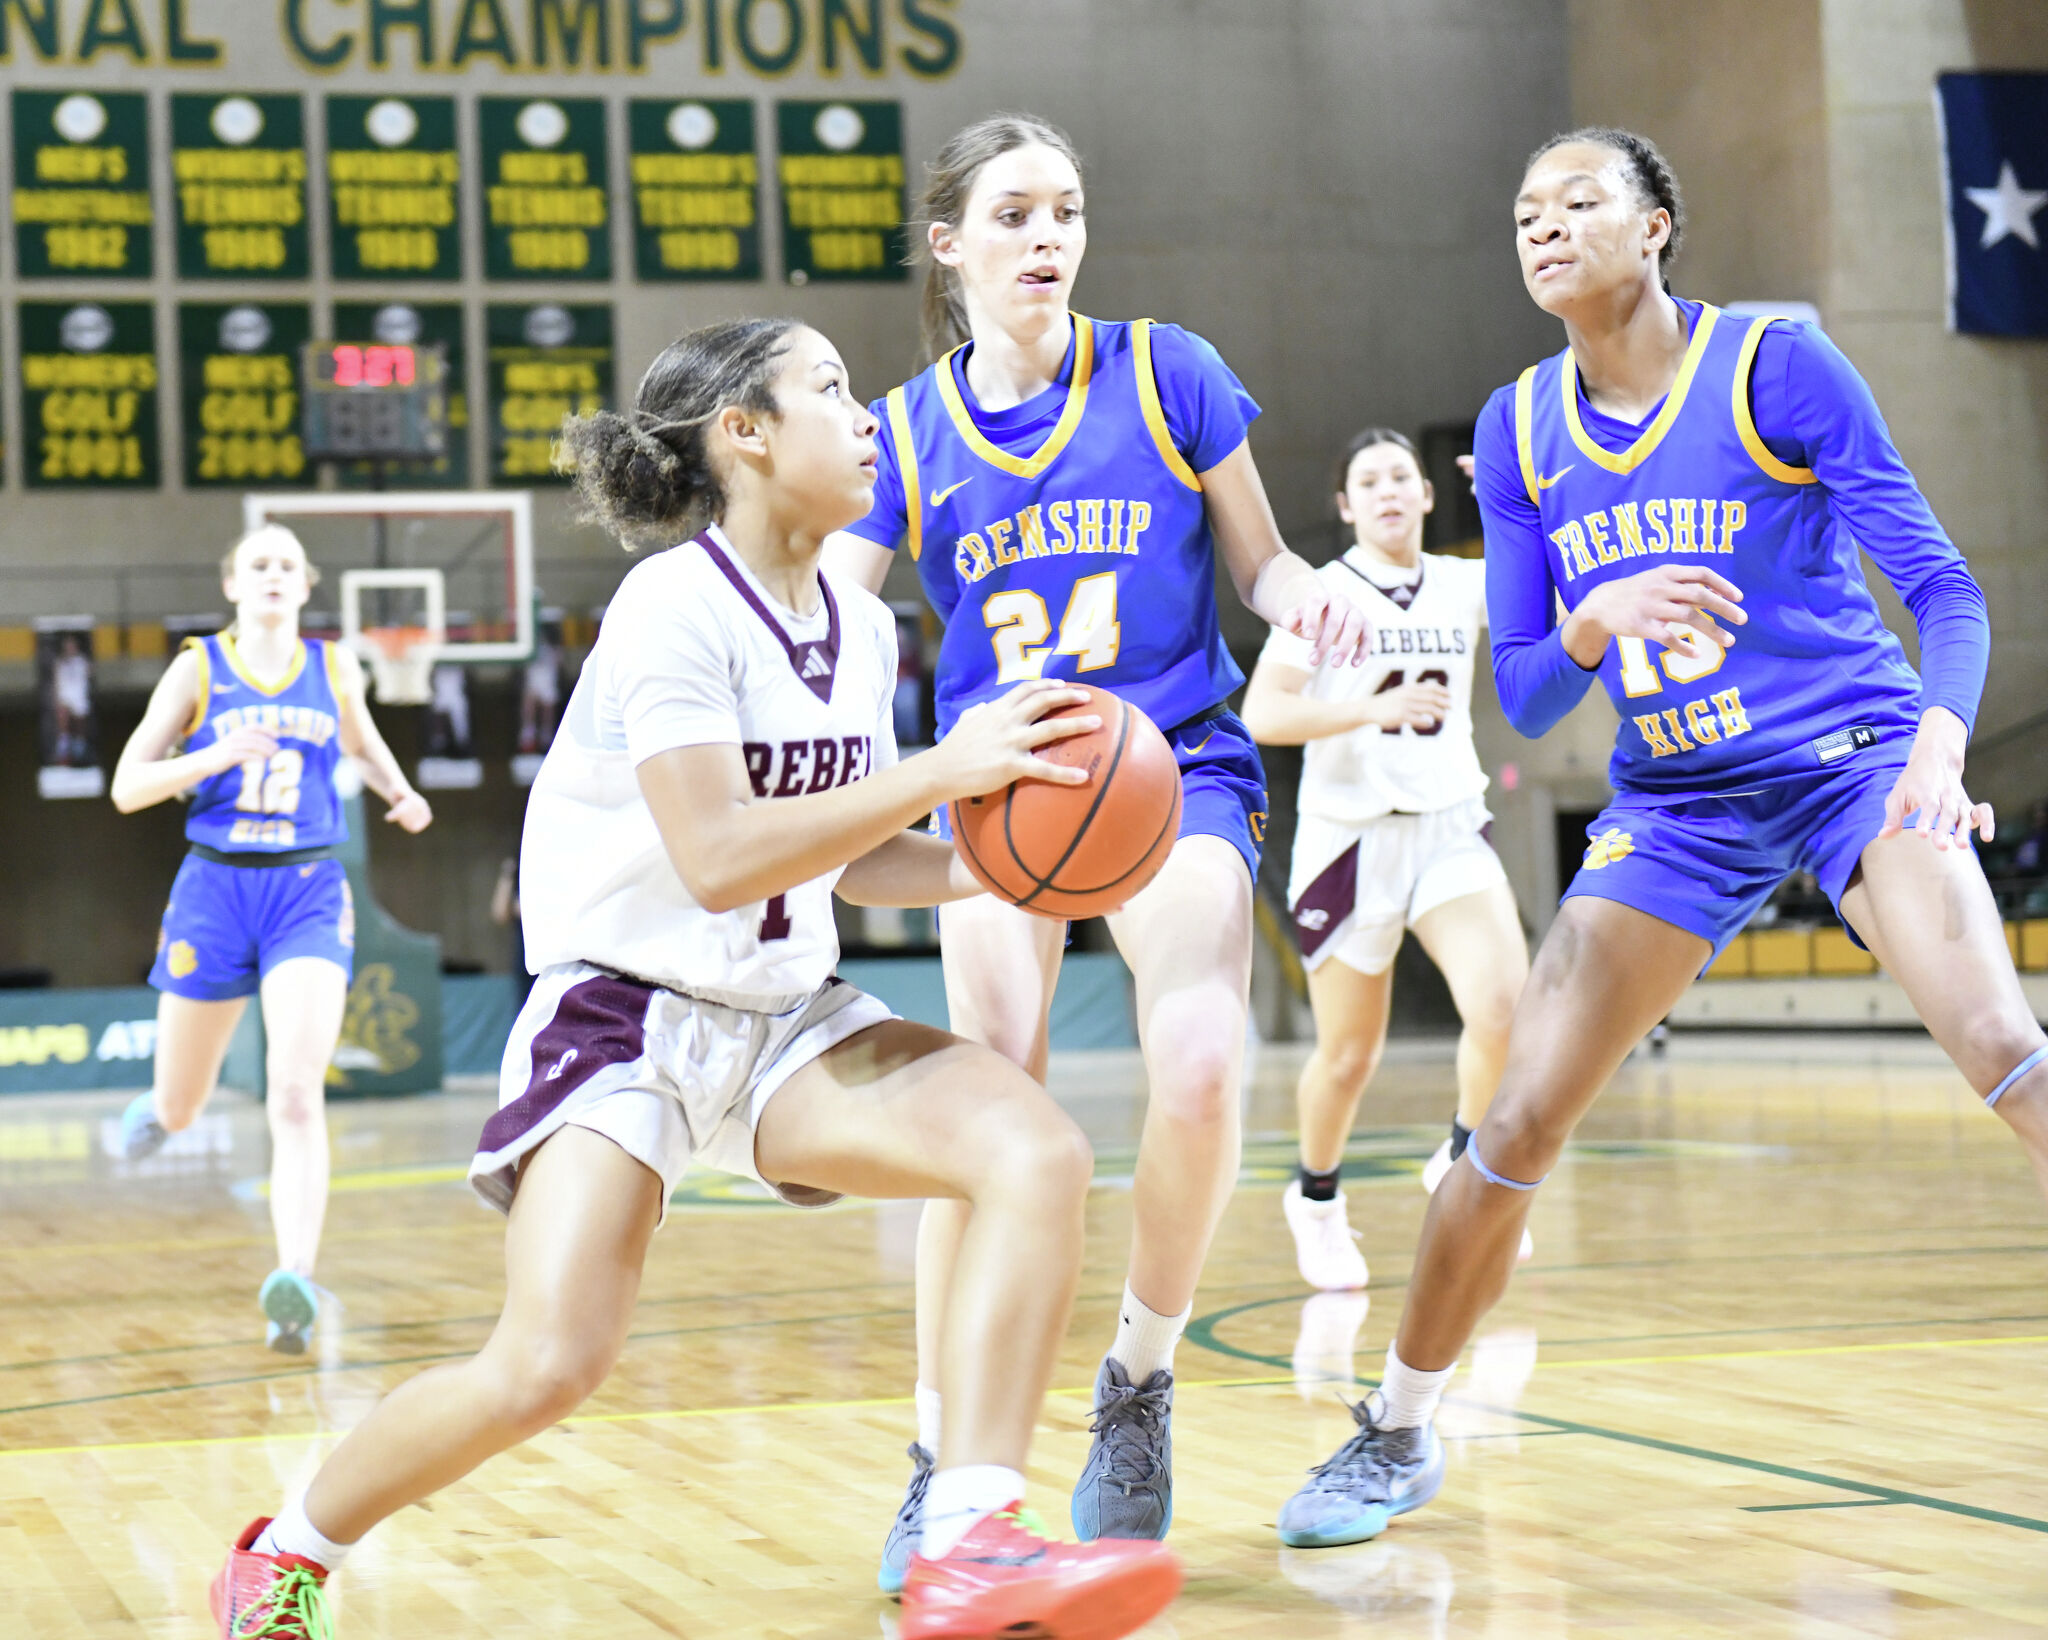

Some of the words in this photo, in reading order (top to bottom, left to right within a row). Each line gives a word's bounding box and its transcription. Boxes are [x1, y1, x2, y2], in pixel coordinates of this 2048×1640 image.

[281, 0, 965, 78] CHAMPIONS
[1548, 498, 1748, 582] FRENSHIP
[981, 570, 1121, 685] 24
[1369, 628, 1466, 655] EBELS
[1634, 686, 1752, 758] HIGH
[1855, 730, 1870, 744] M
[235, 748, 304, 815] 12
[742, 736, 871, 798] REBE
